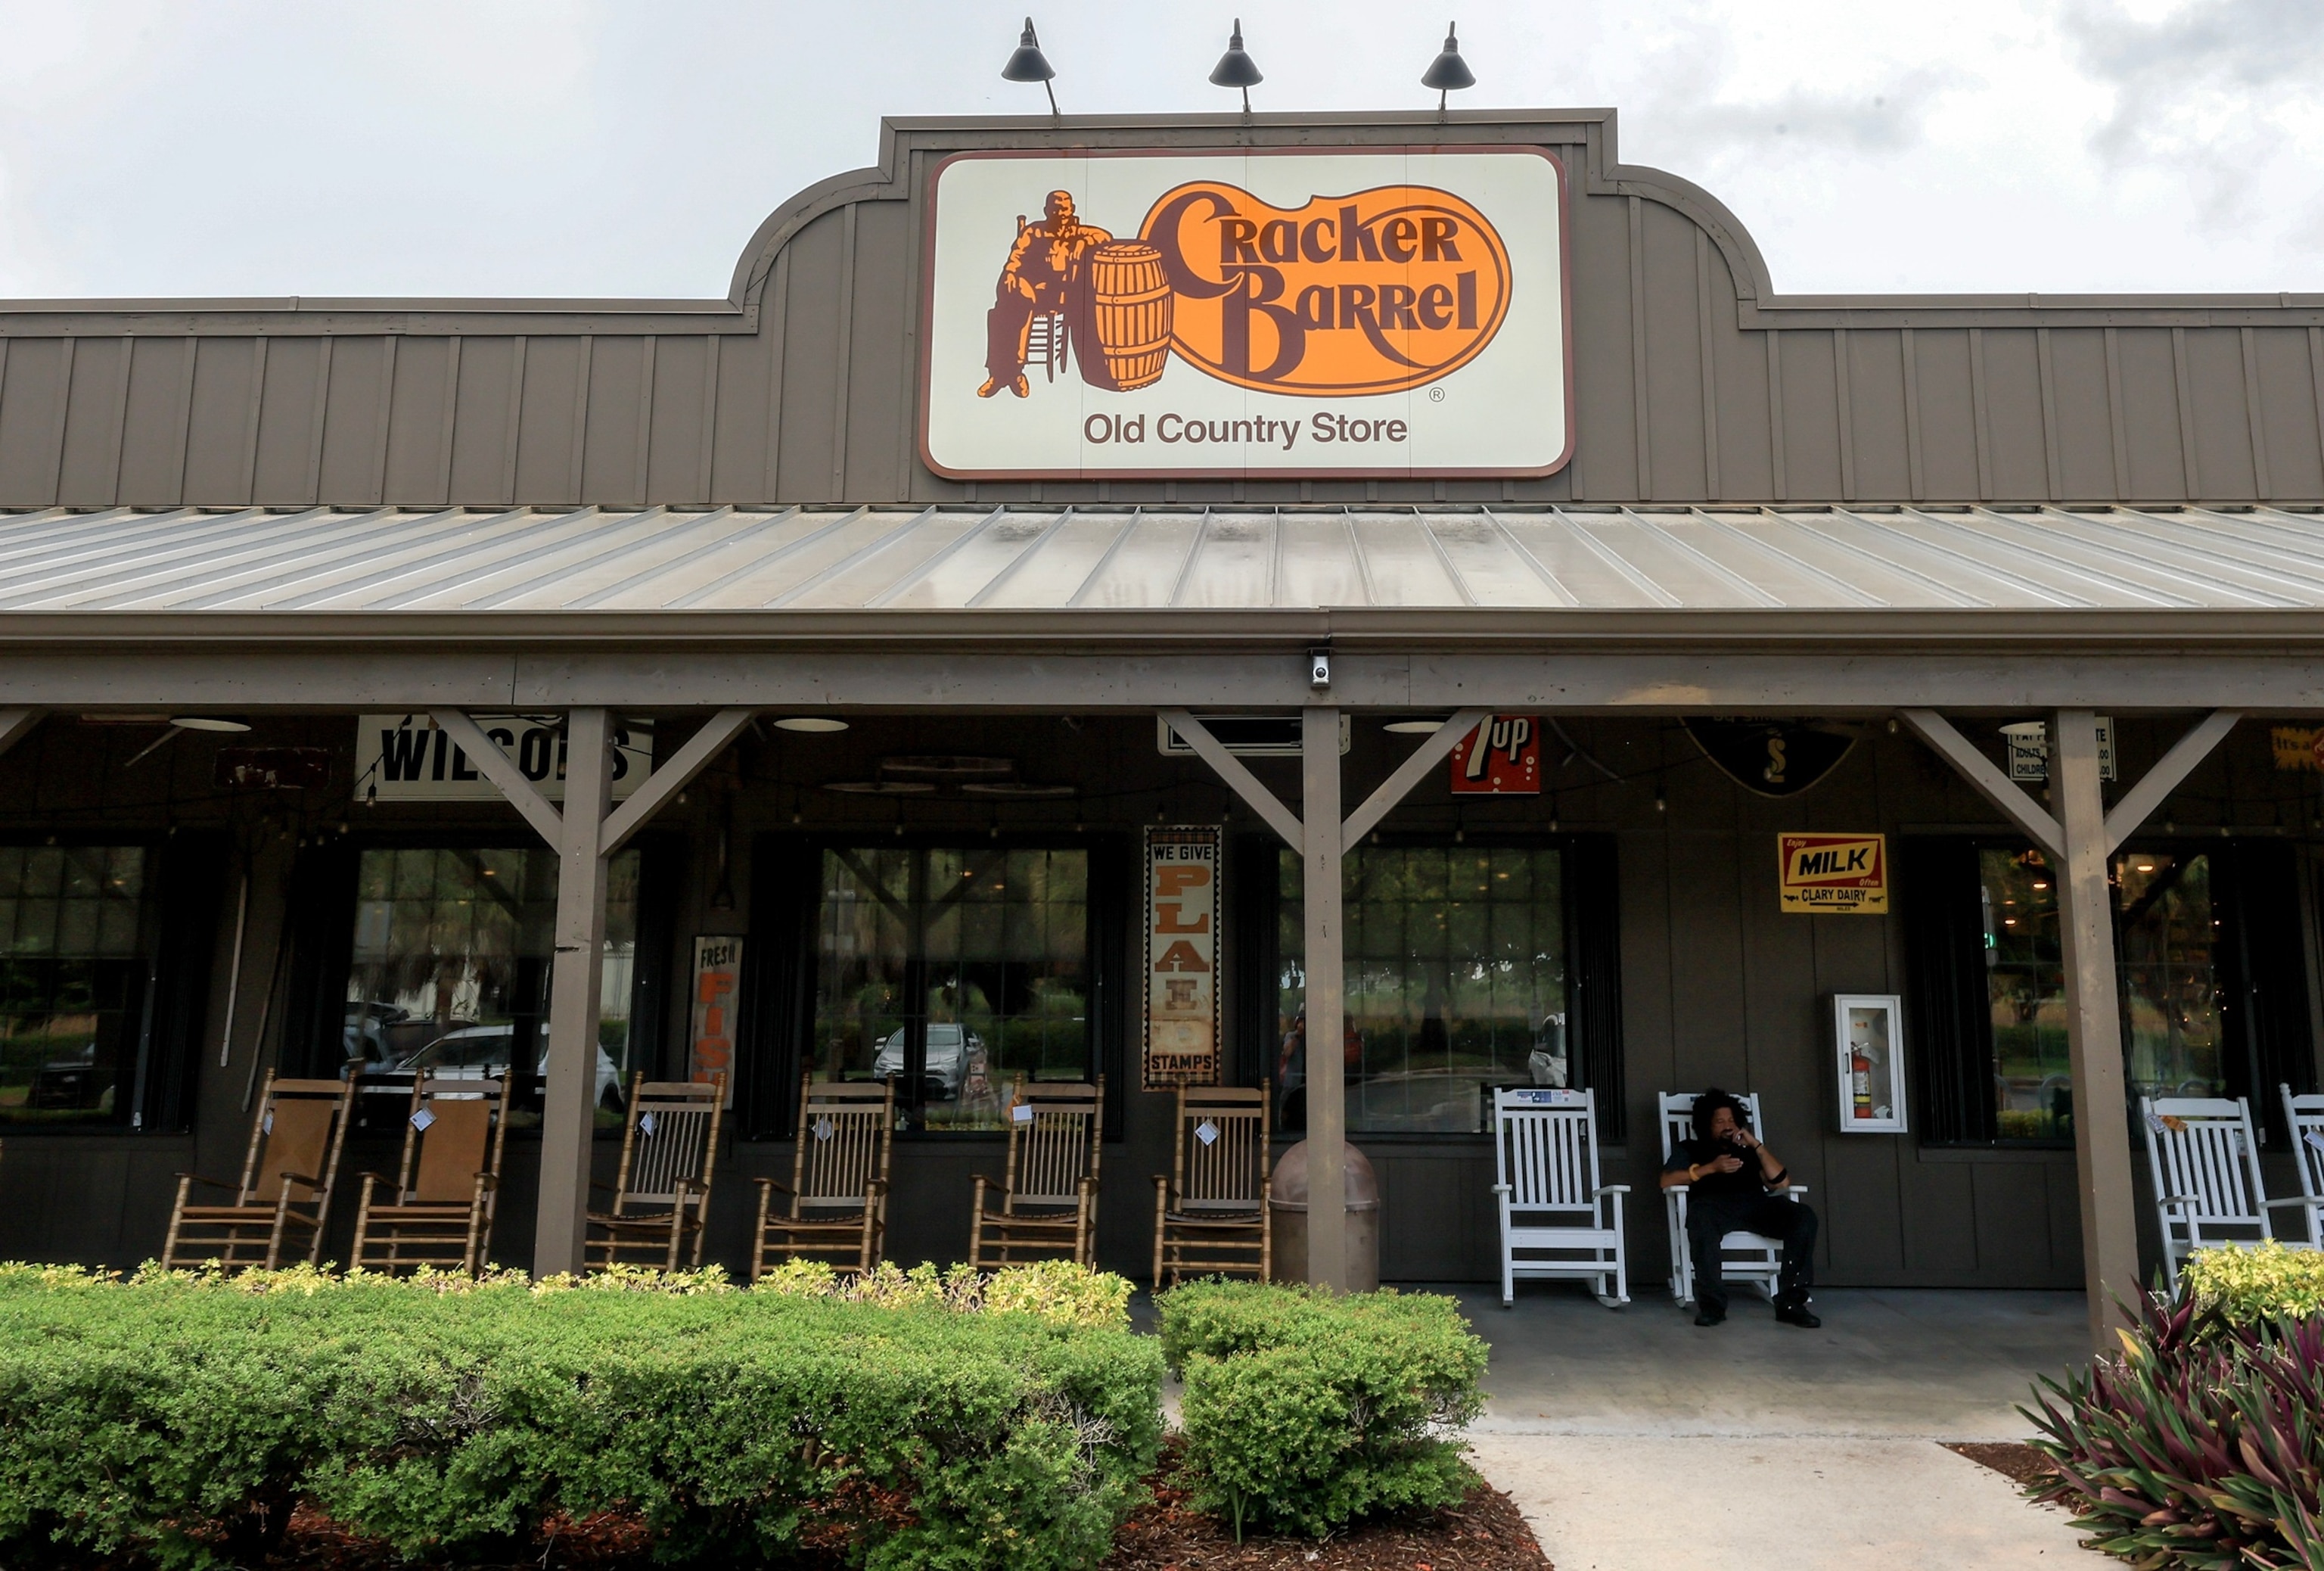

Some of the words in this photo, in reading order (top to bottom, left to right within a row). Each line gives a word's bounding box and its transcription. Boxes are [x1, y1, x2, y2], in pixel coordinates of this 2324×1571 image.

[1084, 413, 1145, 443] Old
[1157, 412, 1301, 450] Country
[1311, 412, 1408, 443] Store
[2016, 764, 2046, 774] CHILDRE
[1787, 838, 1807, 848] Enjoy
[1154, 846, 1174, 860] WE
[1180, 846, 1212, 860] GIVE
[1798, 848, 1869, 876] MILK
[1859, 878, 1879, 887] Often
[1802, 888, 1834, 902] CLARY
[1838, 889, 1866, 902] DAIRY
[701, 944, 736, 969] FRESH
[1152, 1055, 1212, 1070] STAMPS
